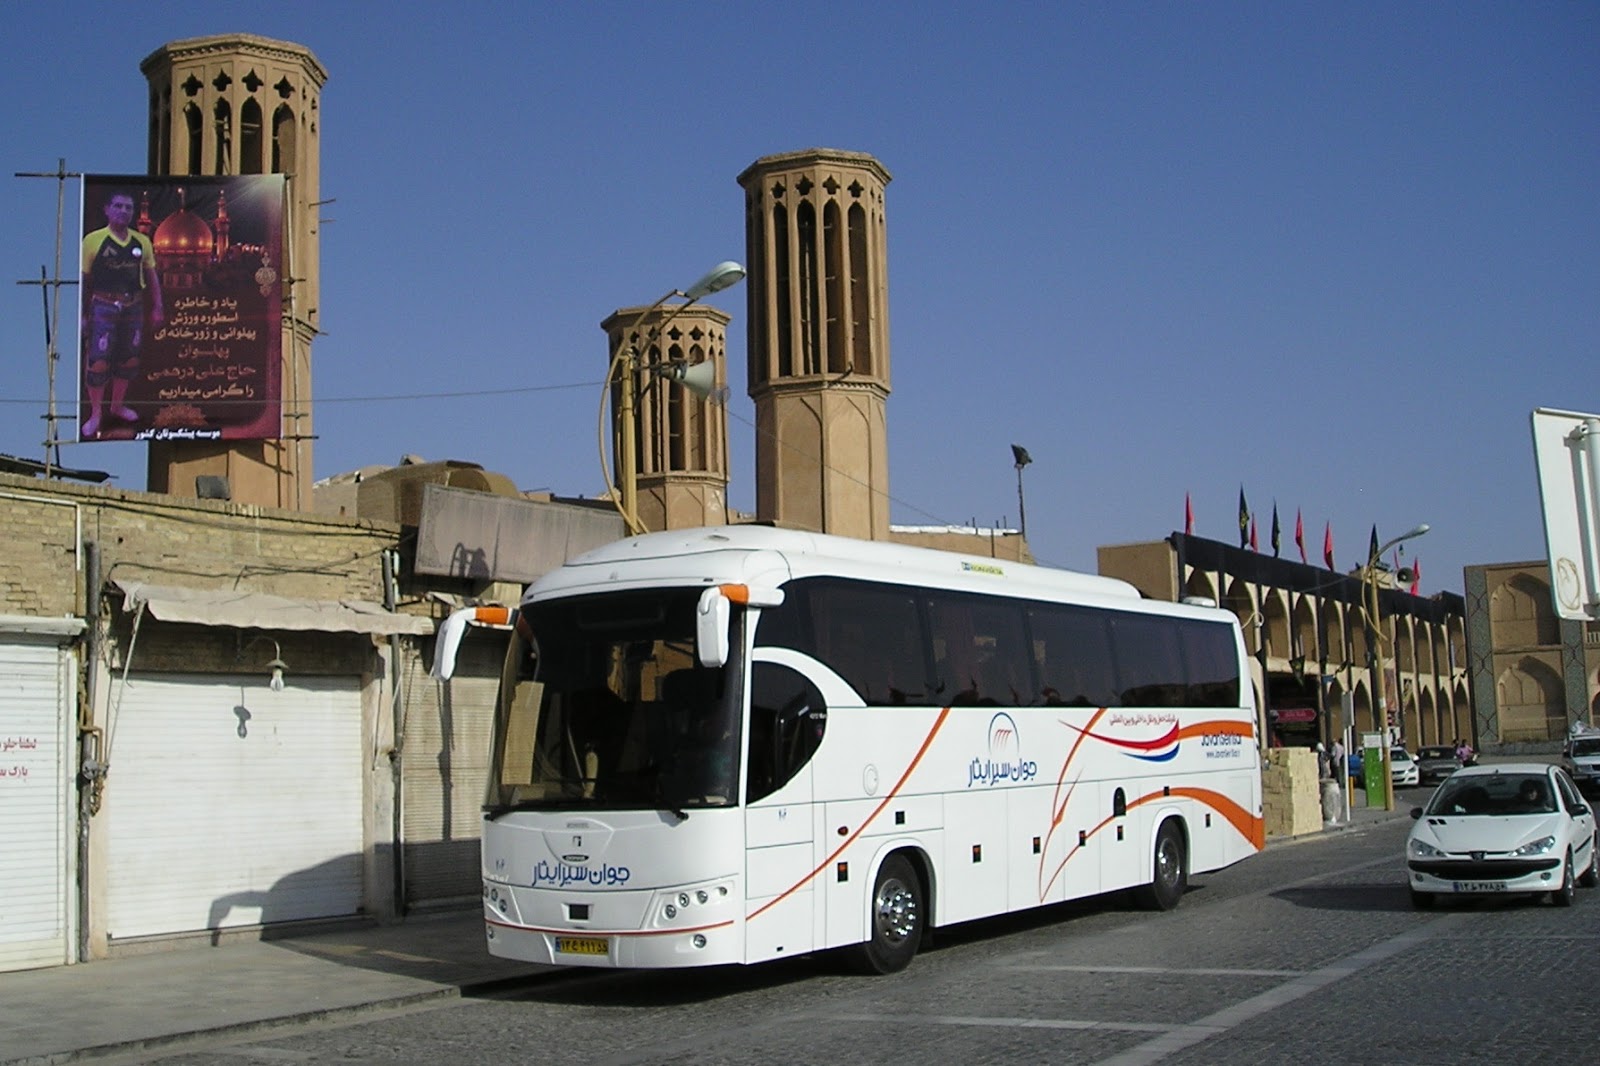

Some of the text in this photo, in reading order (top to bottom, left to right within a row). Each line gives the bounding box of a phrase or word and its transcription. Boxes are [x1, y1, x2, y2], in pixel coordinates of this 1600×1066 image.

[174, 296, 237, 310] یاد و خاطره
[170, 312, 239, 325] اسطوره ورزش
[212, 330, 218, 340] و
[219, 327, 256, 340] پهلوانی
[196, 364, 225, 380] علی
[227, 364, 256, 380] حاج
[202, 382, 244, 399] گرامی
[246, 384, 254, 398] را
[1011, 758, 1037, 781] جوان
[588, 863, 630, 886] جوان
